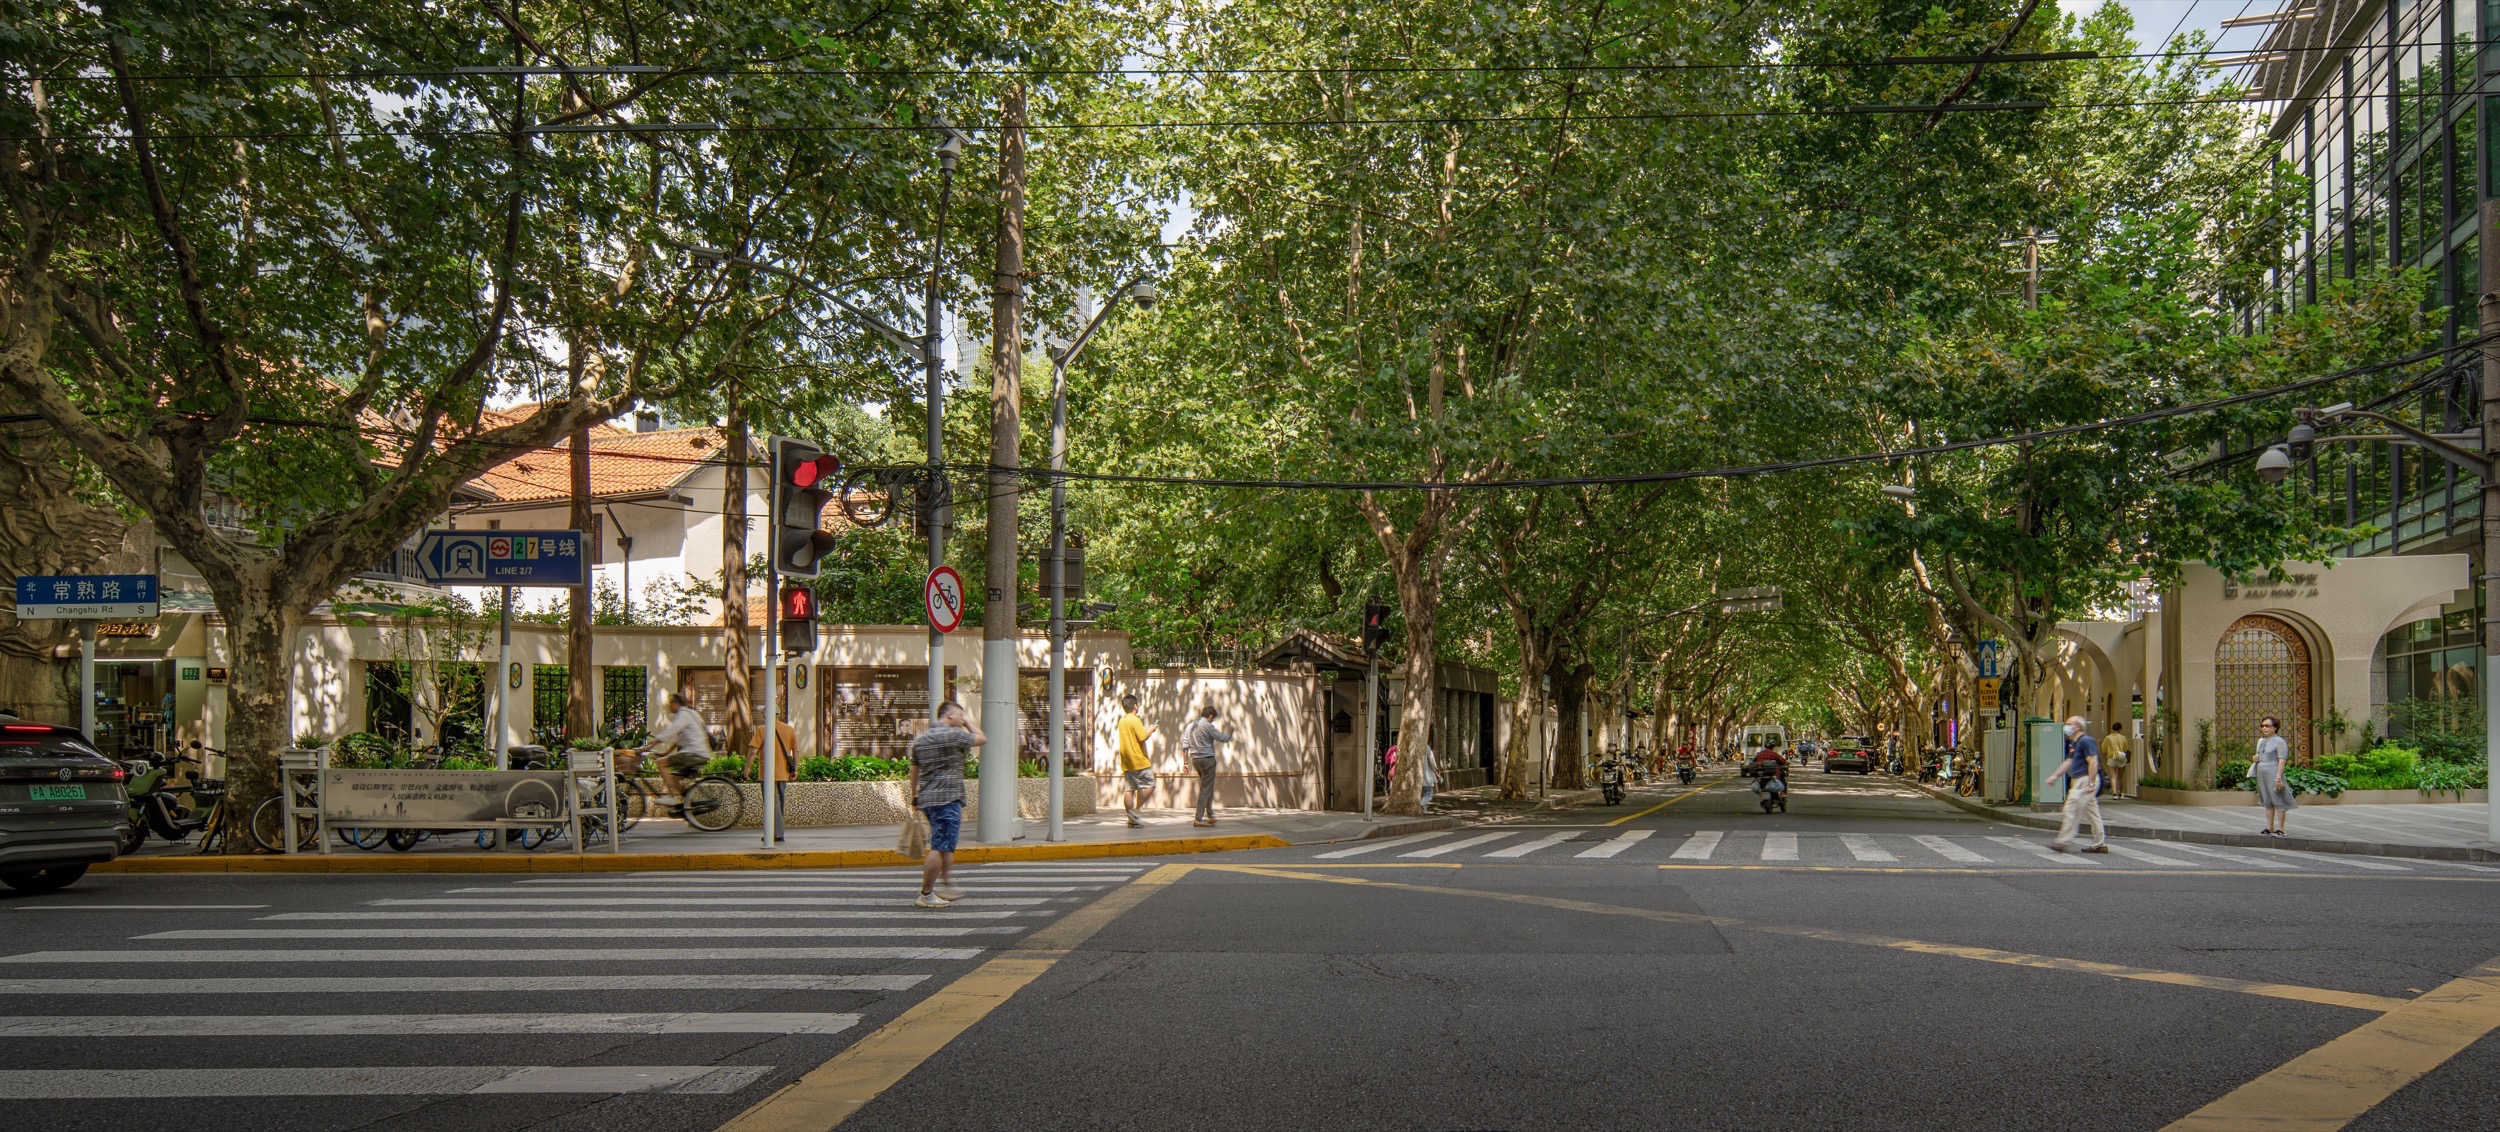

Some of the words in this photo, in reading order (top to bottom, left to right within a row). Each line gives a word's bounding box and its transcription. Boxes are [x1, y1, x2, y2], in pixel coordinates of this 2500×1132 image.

[540, 539, 576, 557] 号线
[495, 567, 517, 575] LINE
[519, 567, 533, 575] 2/7
[26, 581, 37, 592] 北
[53, 580, 121, 600] 常熟路
[136, 580, 147, 591] 南
[27, 607, 35, 615] N
[56, 606, 98, 615] Changshu
[101, 605, 116, 613] Rd.
[137, 605, 145, 614] S
[184, 668, 198, 676] 892
[49, 786, 84, 798] A80261
